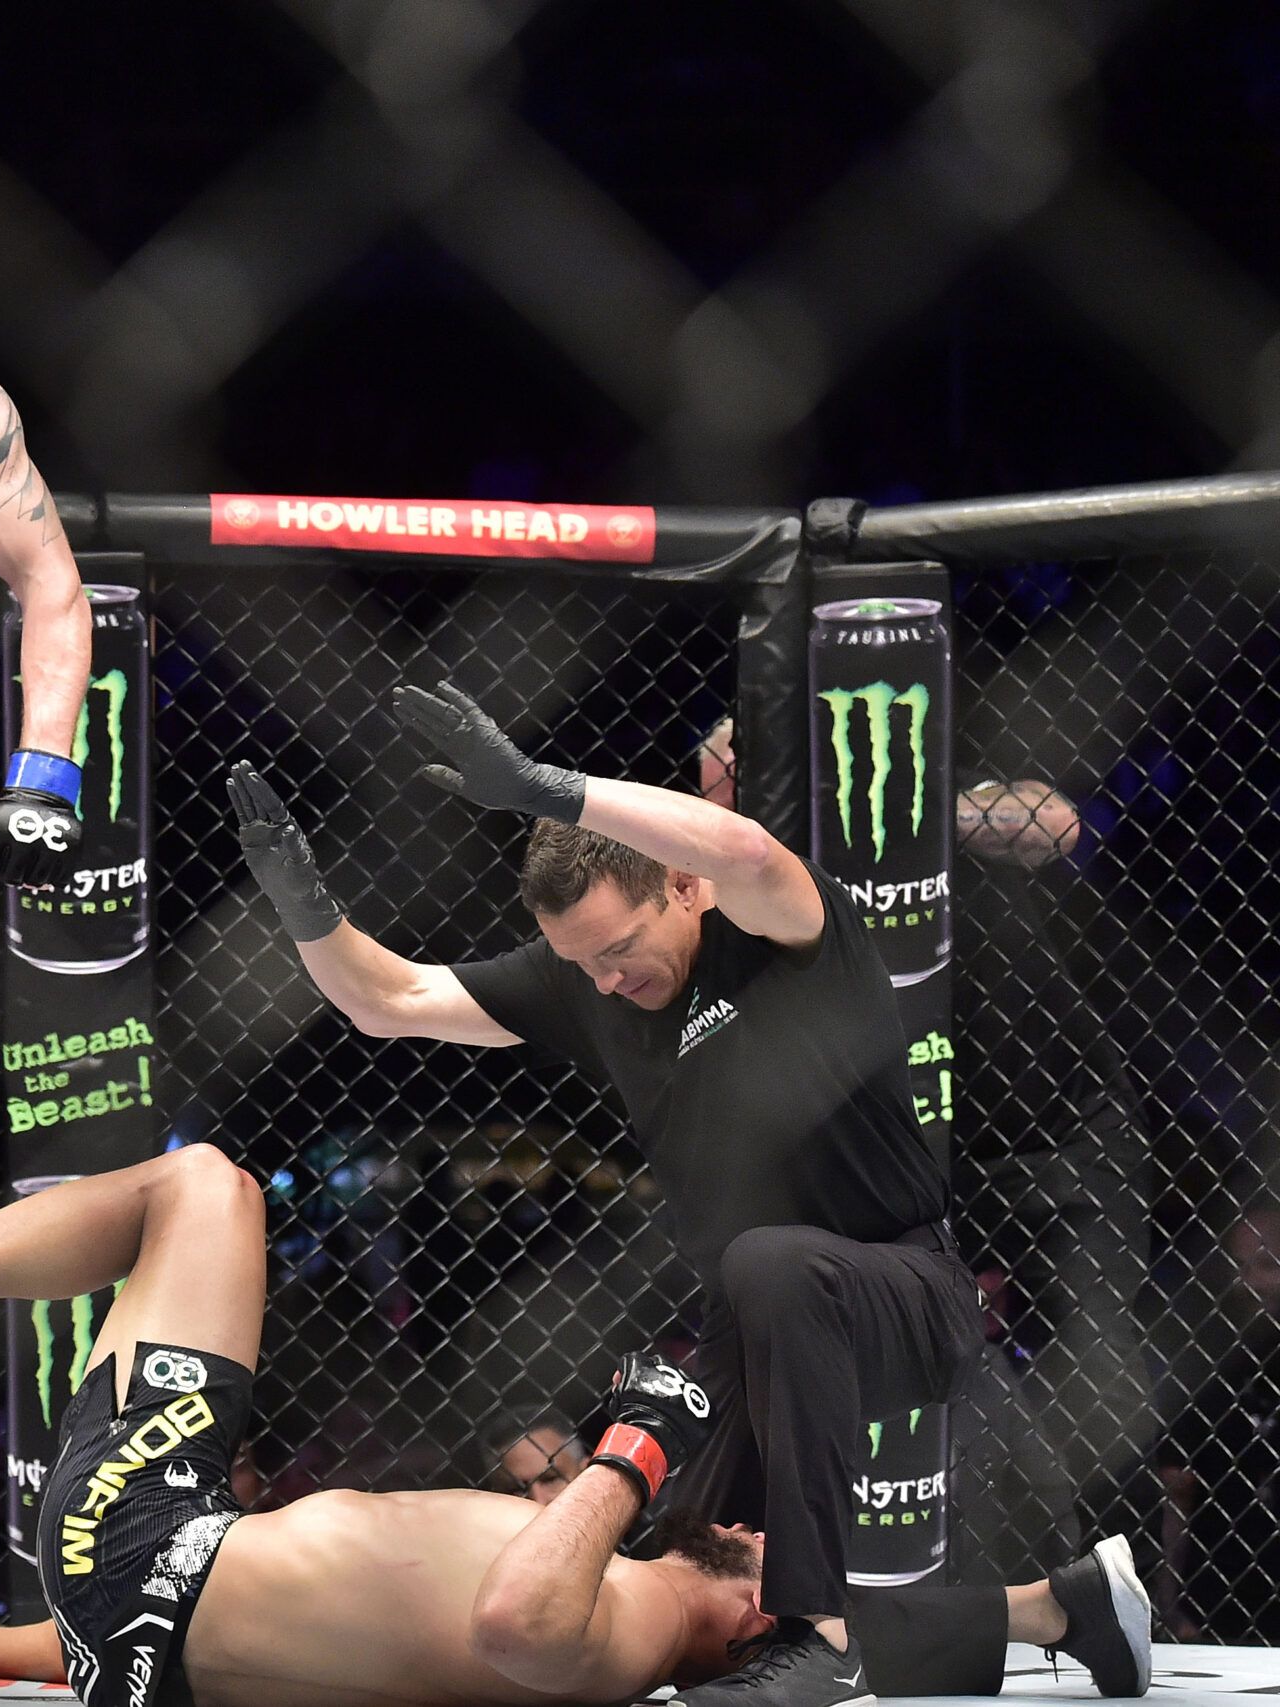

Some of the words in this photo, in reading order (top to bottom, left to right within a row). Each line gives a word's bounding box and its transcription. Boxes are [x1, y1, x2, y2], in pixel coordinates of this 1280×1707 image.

[277, 501, 457, 538] HOWLER
[471, 508, 588, 543] HEAD
[21, 896, 133, 915] ENERGY
[835, 870, 950, 912] NSTER
[863, 909, 935, 929] ERGY
[2, 1017, 154, 1071] Unleash
[679, 999, 734, 1047] ABMMA
[7, 1055, 153, 1134] Beast!
[24, 1072, 70, 1094] the
[62, 1391, 215, 1576] BONFIM
[852, 1470, 947, 1509] NSTER
[857, 1509, 931, 1526] ERGY
